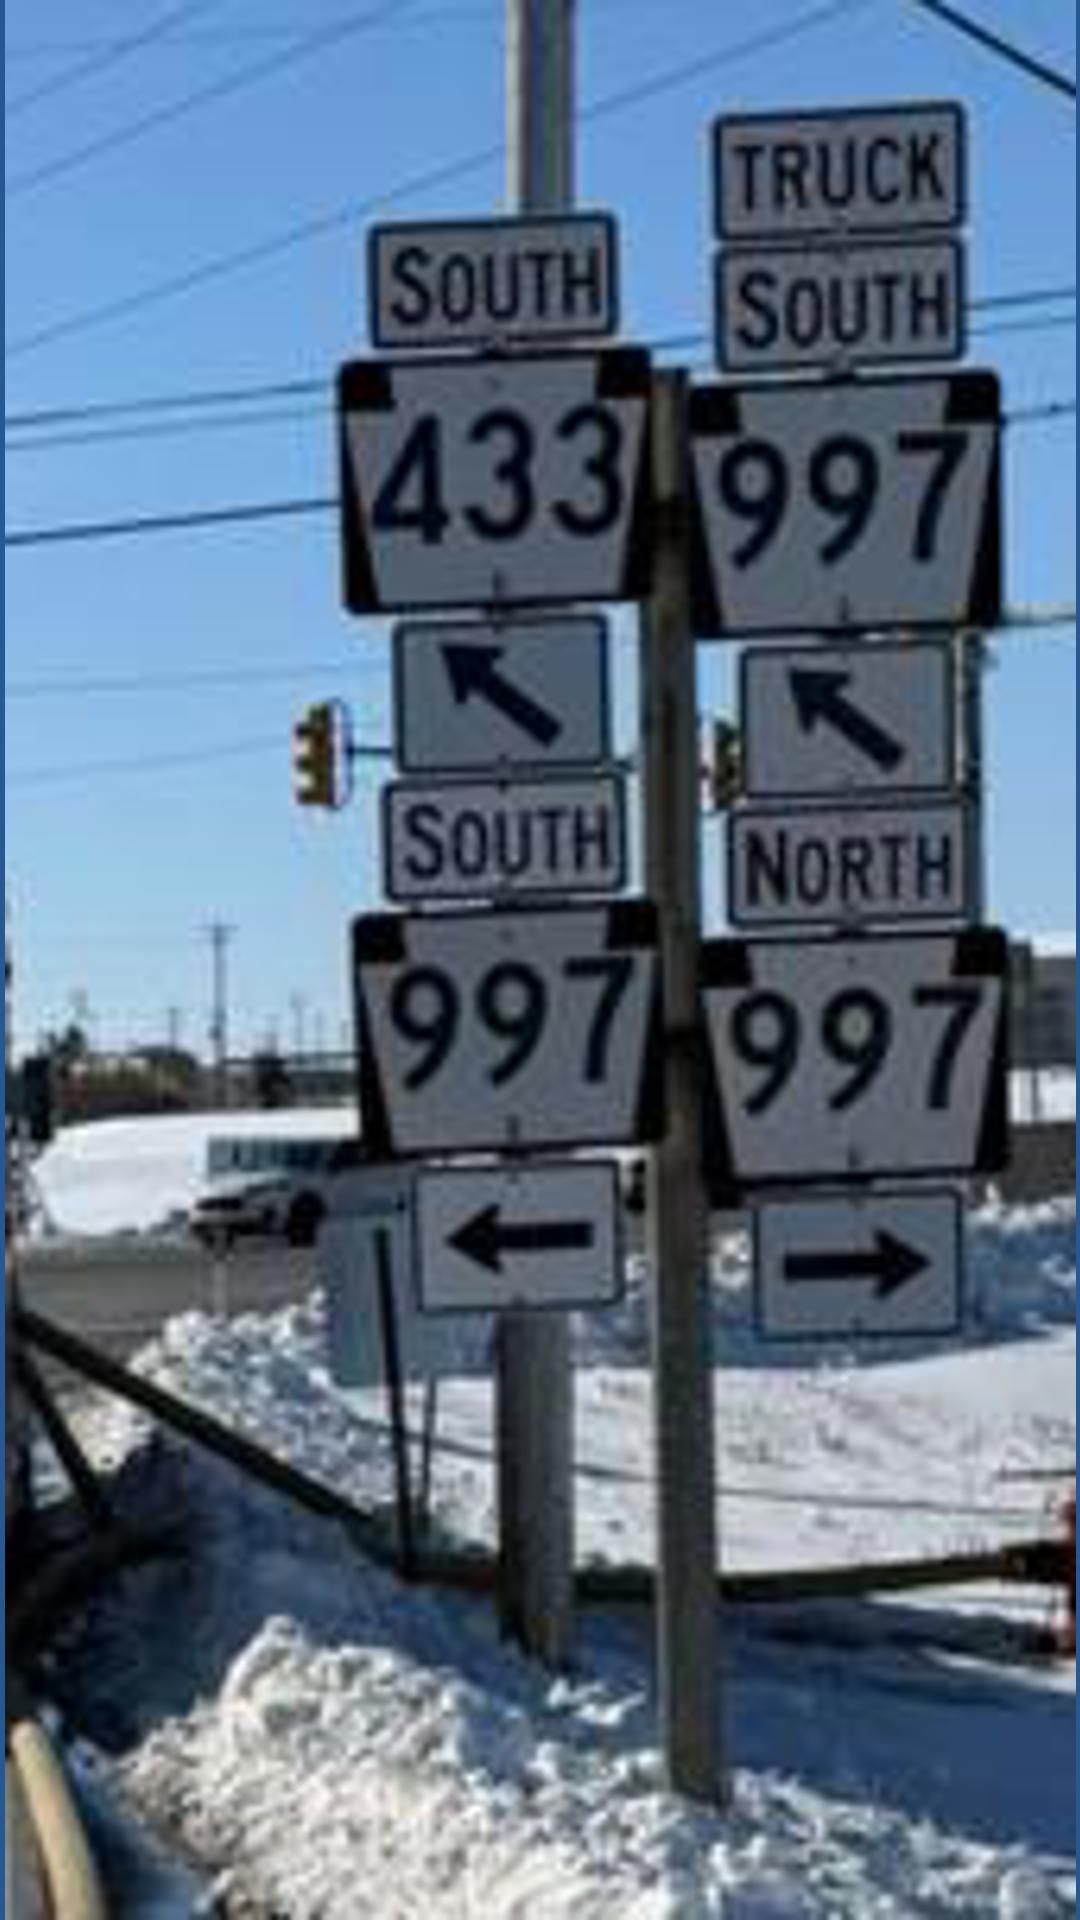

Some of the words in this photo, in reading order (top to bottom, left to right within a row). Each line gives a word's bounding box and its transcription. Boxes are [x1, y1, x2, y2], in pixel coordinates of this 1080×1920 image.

[733, 132, 944, 209] TRUCK
[391, 245, 600, 325] SOUTH
[737, 270, 949, 350] SOUTH
[372, 405, 624, 545] 433
[718, 431, 970, 568] 997
[404, 803, 610, 880] SOUTH
[746, 830, 951, 905] NORTH
[390, 956, 634, 1090] 997
[730, 985, 983, 1114] 997
